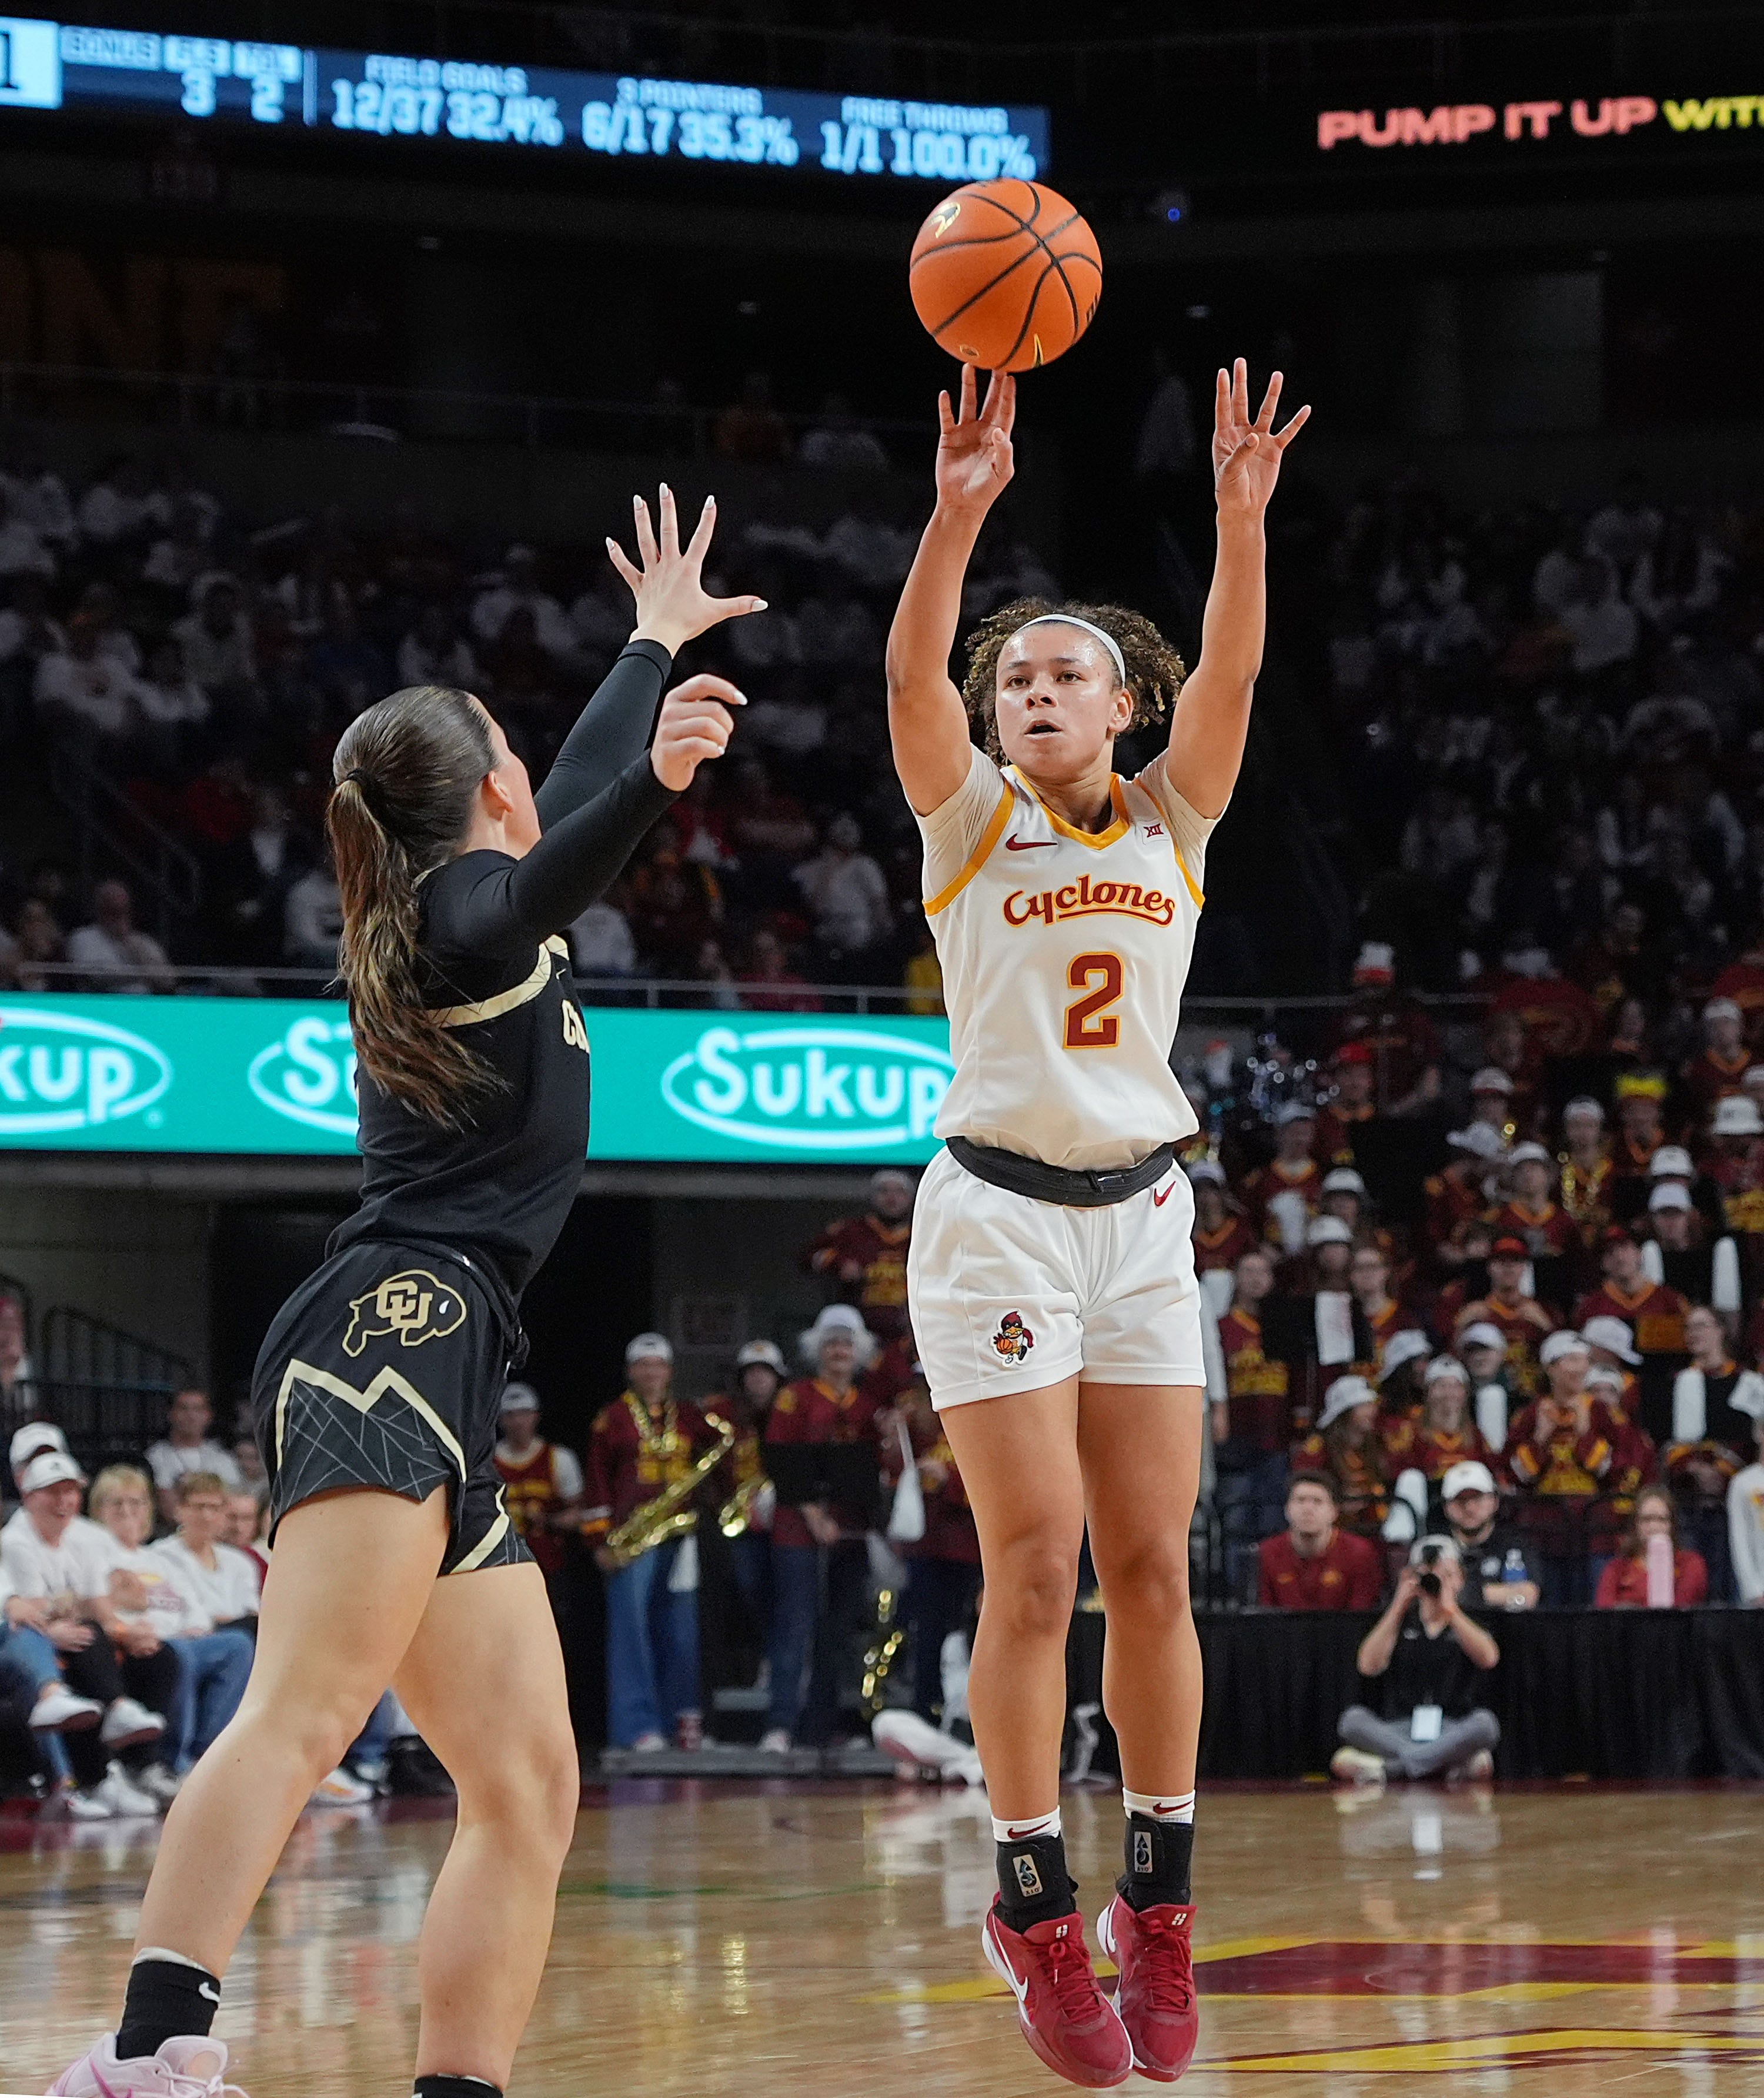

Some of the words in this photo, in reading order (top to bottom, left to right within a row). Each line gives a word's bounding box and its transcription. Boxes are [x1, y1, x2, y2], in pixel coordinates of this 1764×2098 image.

[181, 69, 216, 116] 3
[251, 76, 284, 122] 2
[366, 55, 441, 87] FIELD
[442, 61, 528, 96] GOALS
[331, 78, 444, 136] 12/37
[447, 92, 564, 146] 32.4%
[582, 101, 674, 155] 6/17
[679, 110, 799, 166] 35.3%
[1317, 103, 1496, 149] PUMP
[1504, 100, 1563, 141] IT
[1570, 95, 1658, 136] UP
[1662, 95, 1764, 132] WIT
[820, 121, 884, 174] 1/1
[890, 127, 1036, 181] 100.0%
[1003, 873, 1175, 928] Cyclones
[1063, 951, 1124, 1049] 2
[693, 1027, 949, 1140] Sukup
[376, 1280, 433, 1329] CU
